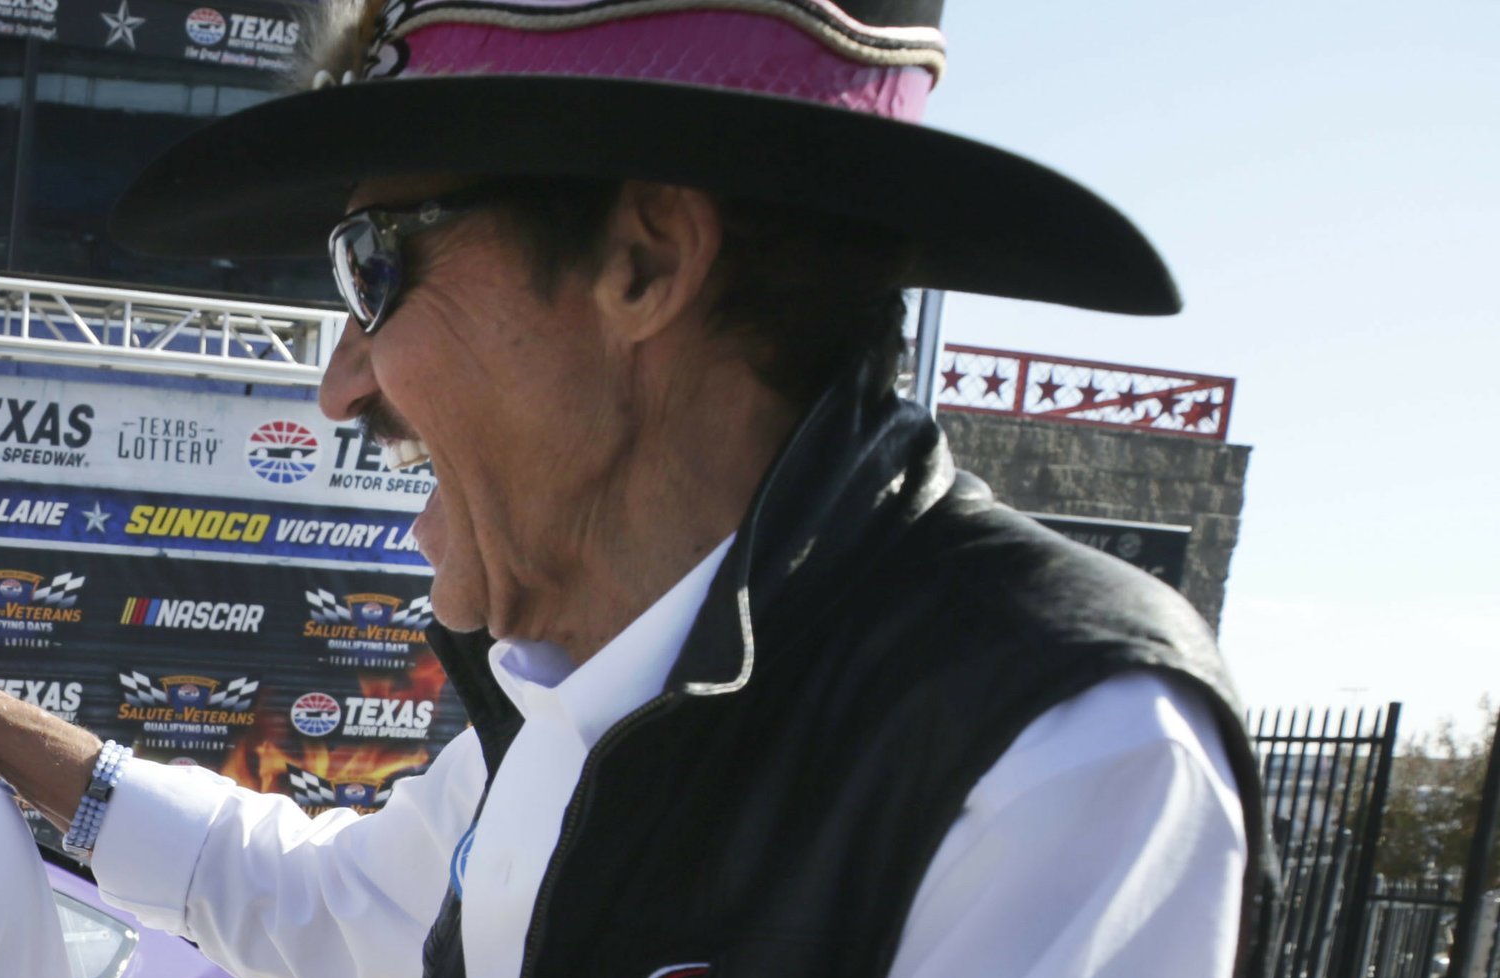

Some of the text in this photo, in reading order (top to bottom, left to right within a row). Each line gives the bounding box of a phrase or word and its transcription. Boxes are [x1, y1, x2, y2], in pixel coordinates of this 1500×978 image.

[229, 14, 299, 45] TEXAS
[139, 416, 198, 438] TEXAS
[3, 448, 85, 467] SPEEDWAY
[118, 431, 217, 465] LOTTERY
[330, 474, 436, 495] MOTOR SPEED
[125, 505, 270, 542] SUNOCO
[275, 518, 384, 549] VICTORY
[383, 526, 420, 551] LA
[4, 603, 82, 622] VETERANS
[155, 599, 264, 632] NASCAR
[27, 621, 52, 632] DAYS
[303, 621, 427, 642] SALUTE VETERAN
[385, 643, 409, 652] DAYS
[117, 703, 255, 725] SALUTE VETERANS
[346, 697, 434, 729] TEXAS
[203, 724, 227, 735] DAYS
[343, 725, 427, 738] MOTOR SPEEDWAY
